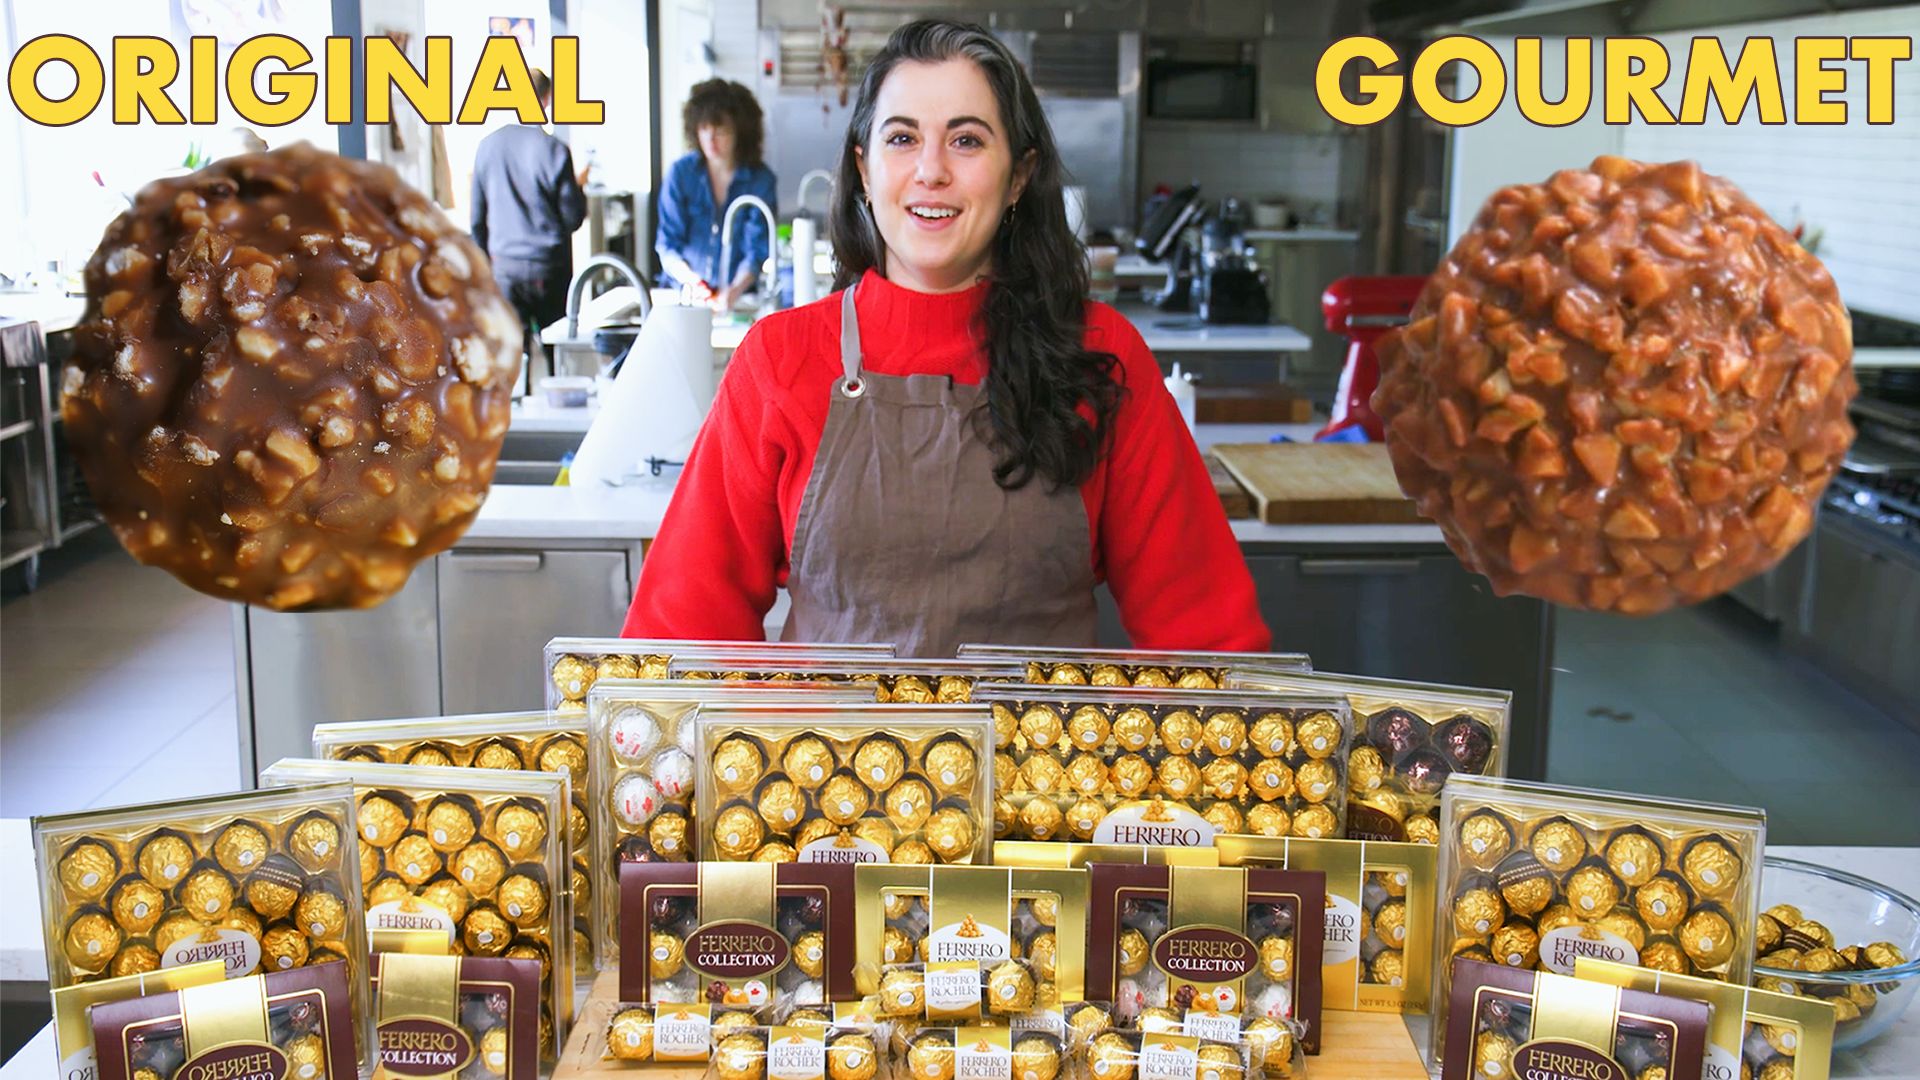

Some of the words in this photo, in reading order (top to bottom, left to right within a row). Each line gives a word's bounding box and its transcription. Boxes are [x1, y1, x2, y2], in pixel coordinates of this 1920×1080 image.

[1113, 825, 1201, 847] FERRERO
[812, 850, 877, 863] FERRERO
[378, 914, 443, 930] FERRERO
[1323, 928, 1353, 942] HER
[698, 935, 776, 953] FERRERO
[937, 942, 1003, 958] FERRERO
[1169, 939, 1246, 959] FERRERO
[1555, 938, 1625, 961] FERRERO
[697, 954, 776, 966] COLLECTION
[1167, 957, 1246, 972] COLLECTION
[930, 975, 976, 986] FERRERO
[931, 985, 977, 997] ROCHER
[660, 1023, 706, 1034] FERRERO
[1190, 1018, 1236, 1030] FERRERO
[660, 1033, 706, 1044] ROCHER
[1189, 1027, 1234, 1041] ROCHER
[379, 1031, 458, 1051] FERRERO
[773, 1046, 821, 1057] FERRERO
[773, 1057, 821, 1068] ROCHER
[960, 1056, 1007, 1067] FERRERO
[1145, 1052, 1193, 1065] FERRERO
[1528, 1049, 1612, 1080] FERRERO
[960, 1066, 1007, 1078] ROCHER
[1145, 1063, 1193, 1078] ROCHER
